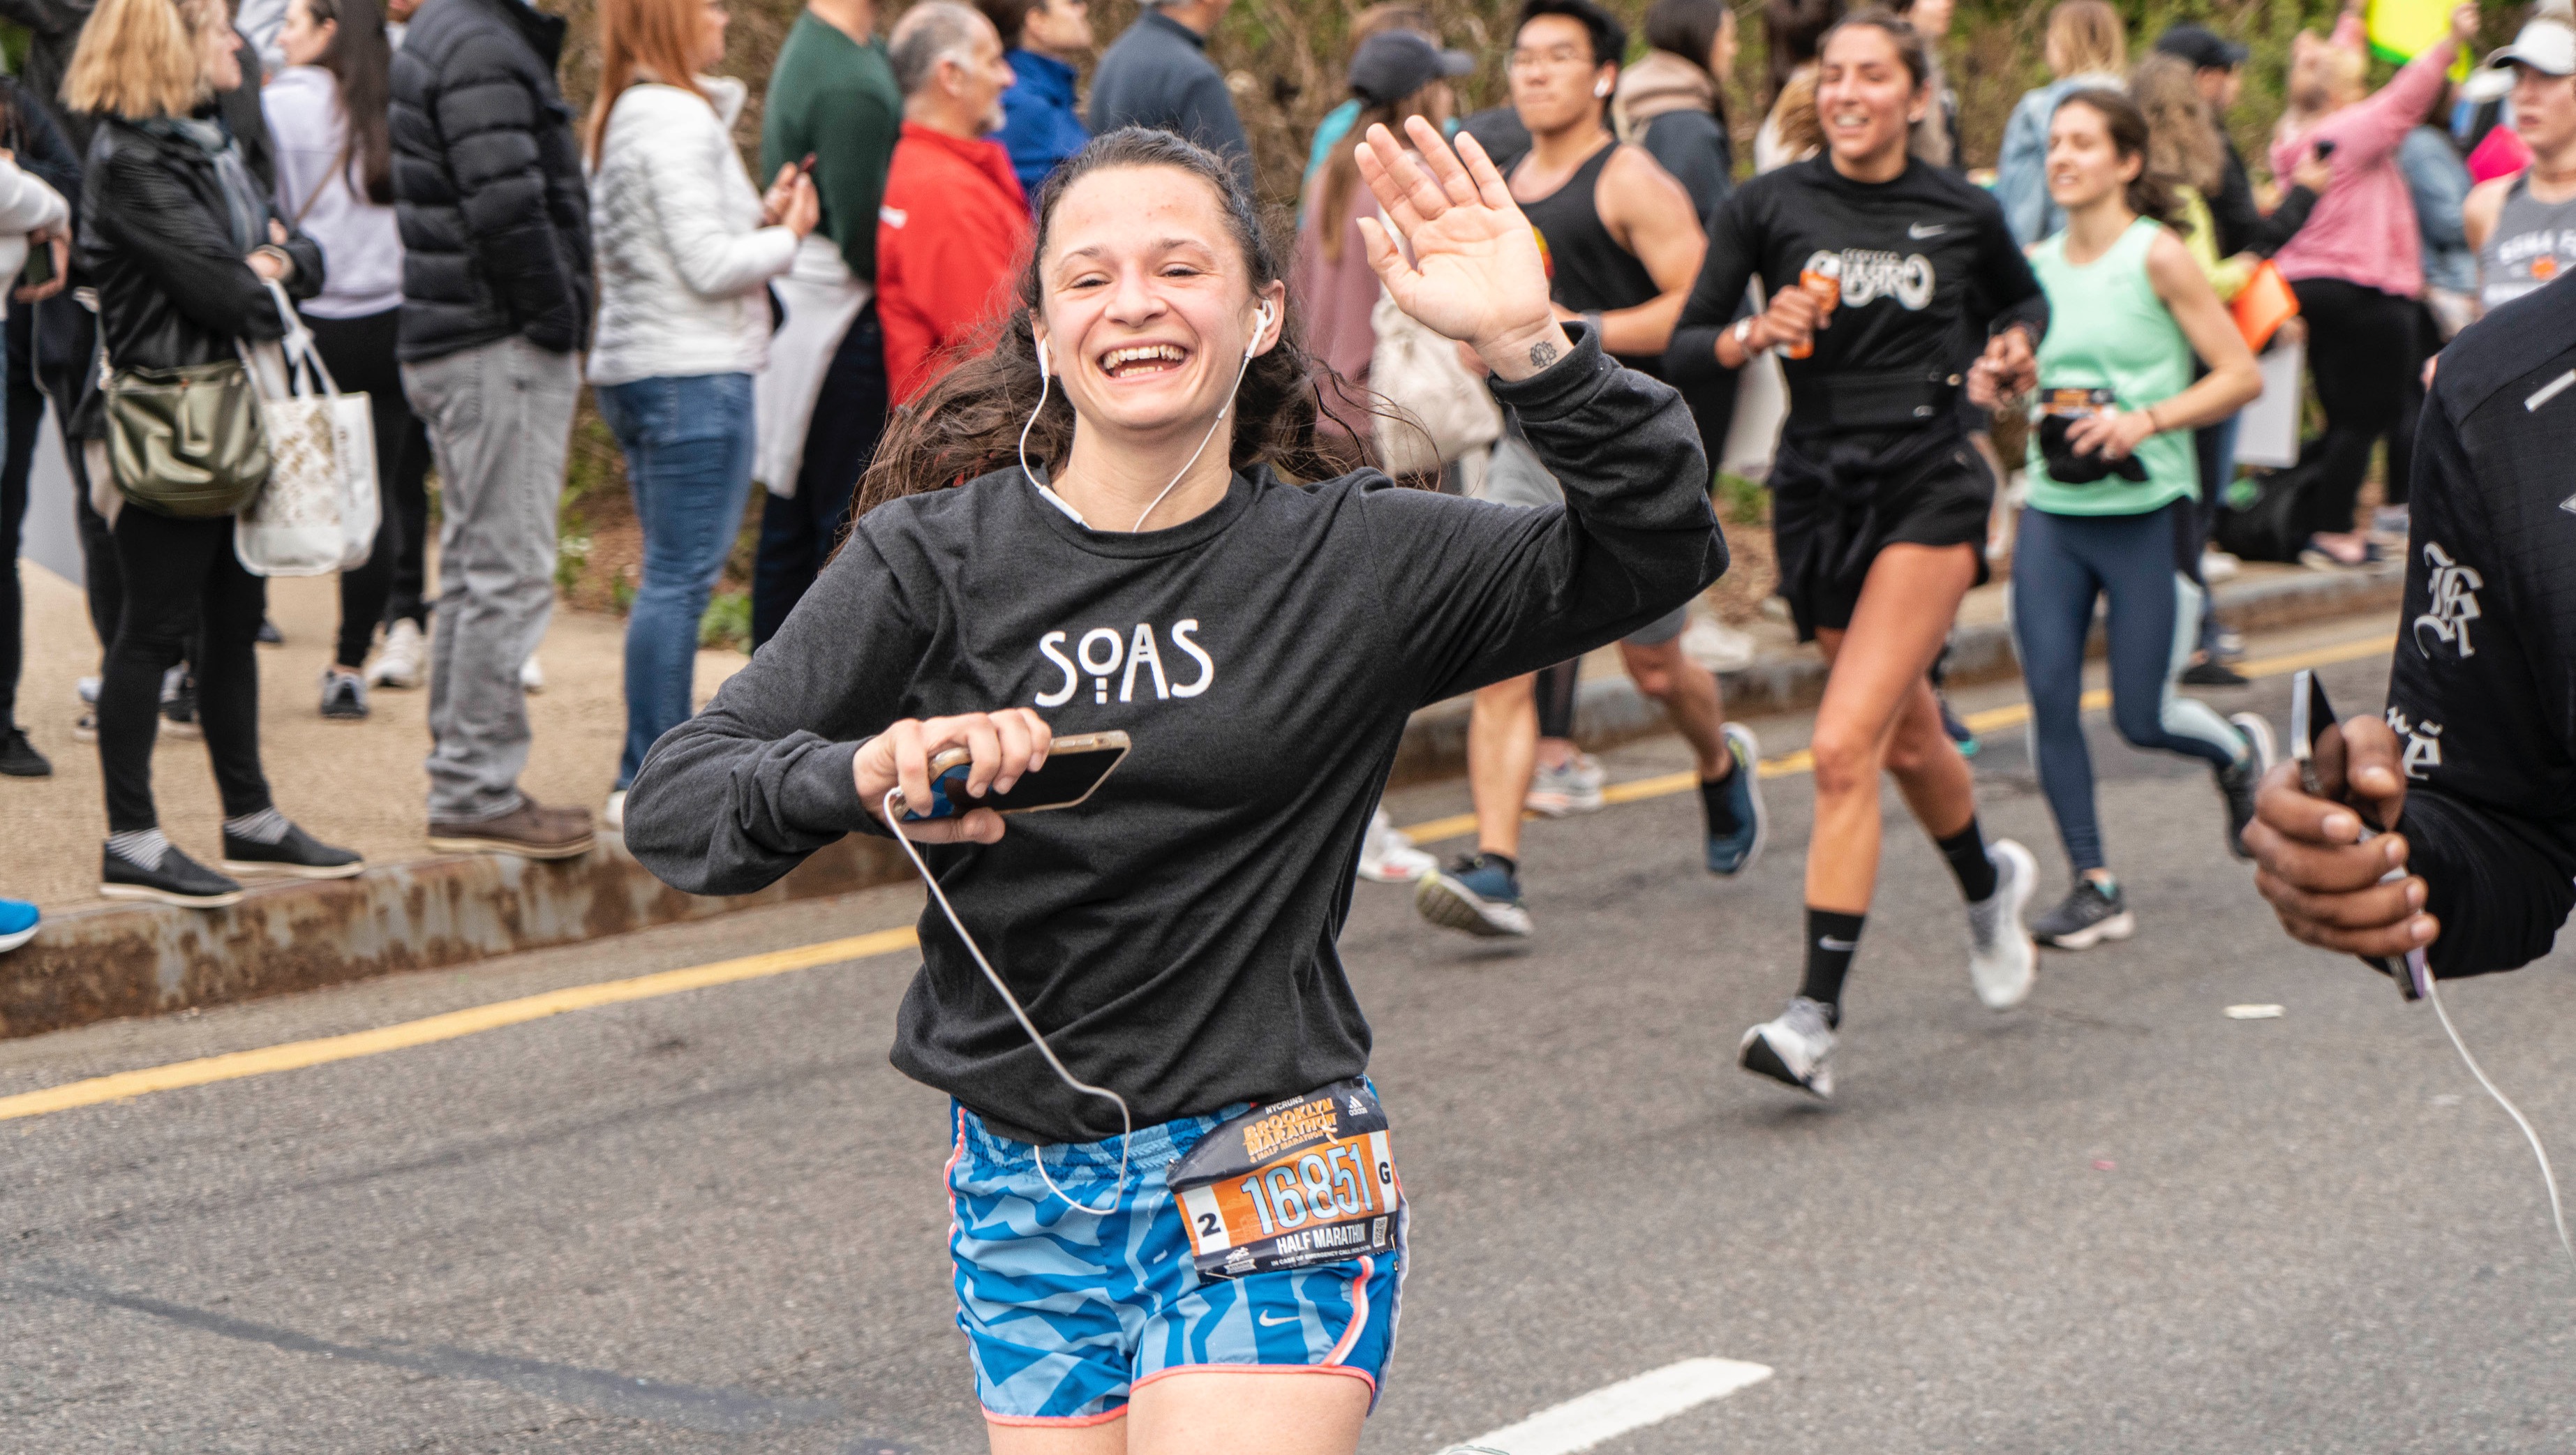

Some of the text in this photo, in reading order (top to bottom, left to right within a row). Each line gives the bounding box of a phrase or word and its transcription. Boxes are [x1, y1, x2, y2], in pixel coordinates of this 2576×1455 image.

[1243, 1098, 1334, 1139] BROOKLYN
[1265, 1095, 1304, 1114] NYCRUNS
[1245, 1112, 1337, 1156] MARATHON
[1258, 1147, 1279, 1161] HALF
[1280, 1129, 1324, 1150] MARATHON
[1198, 1143, 1391, 1238] 2 16851 G
[1276, 1231, 1311, 1255] HALF
